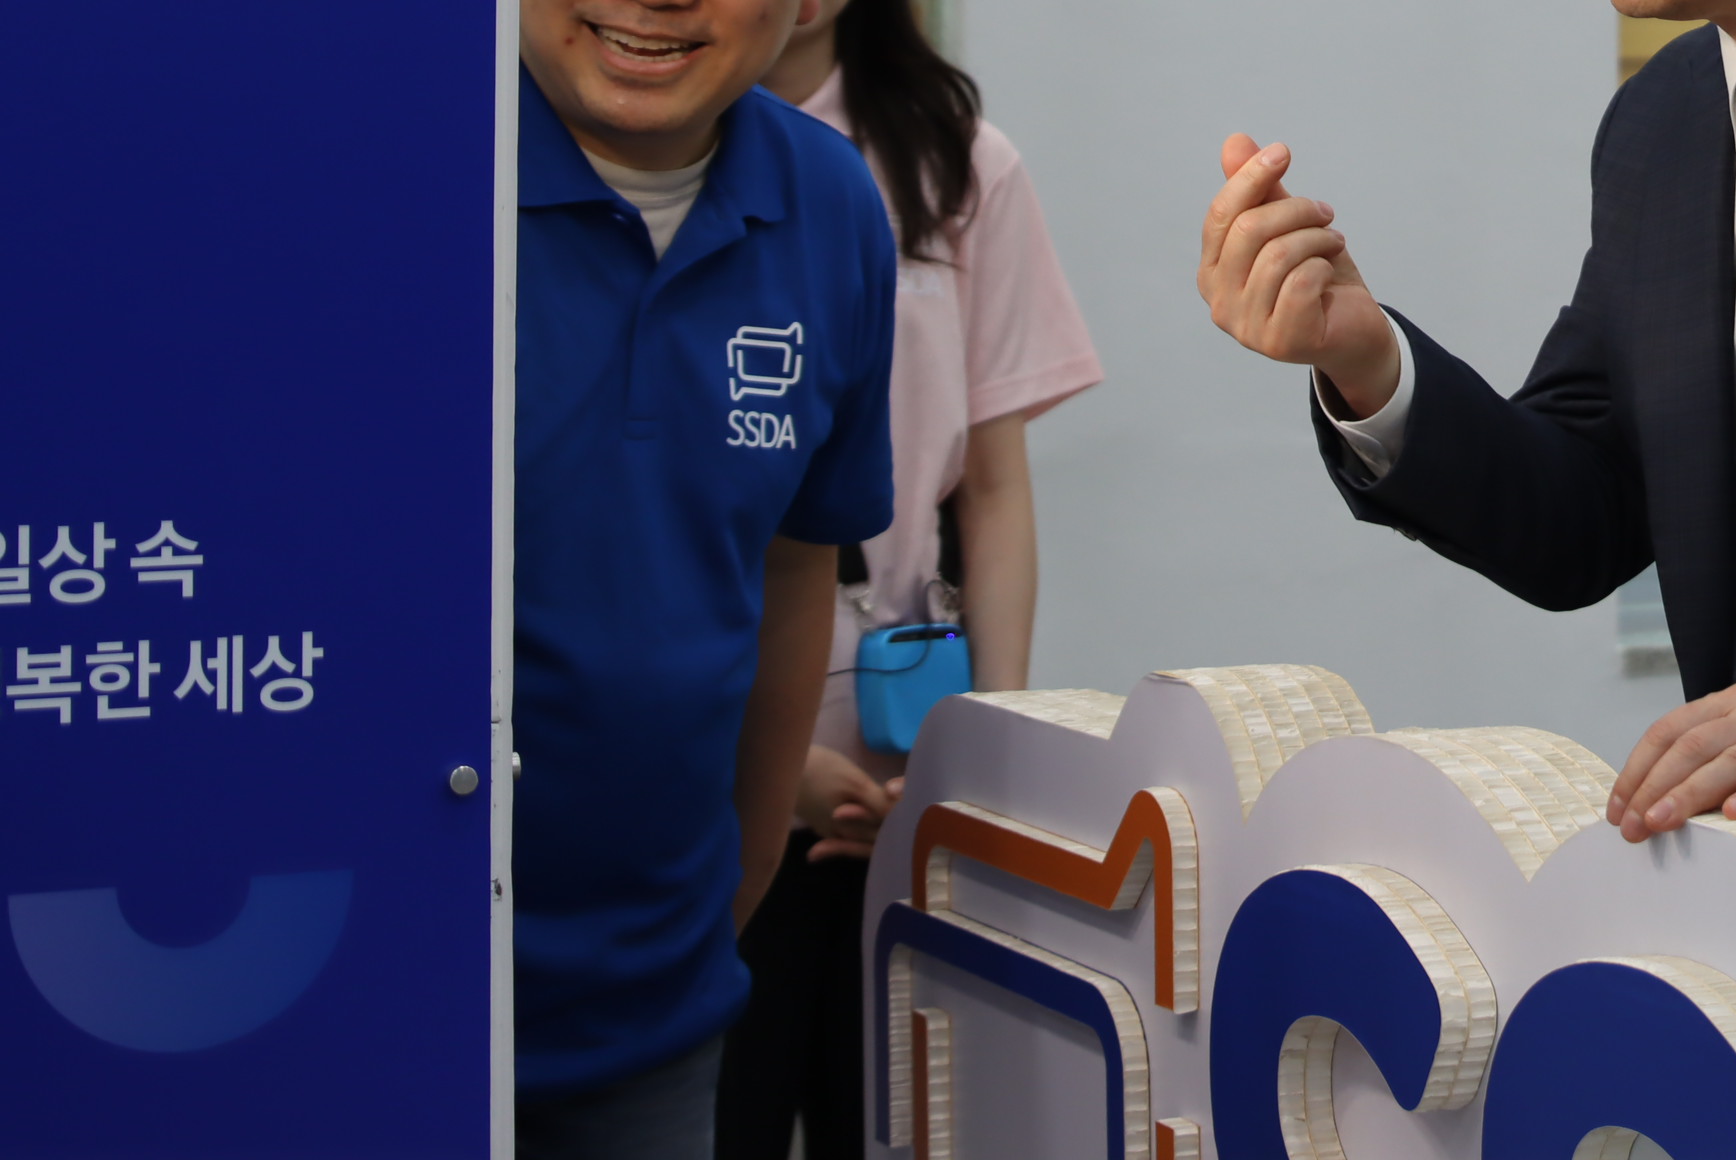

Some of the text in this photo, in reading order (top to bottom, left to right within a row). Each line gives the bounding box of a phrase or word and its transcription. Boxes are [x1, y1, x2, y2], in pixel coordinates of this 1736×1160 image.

[727, 409, 797, 450] SSDA
[130, 520, 204, 598] 속
[6, 631, 324, 724] 복한 세상
